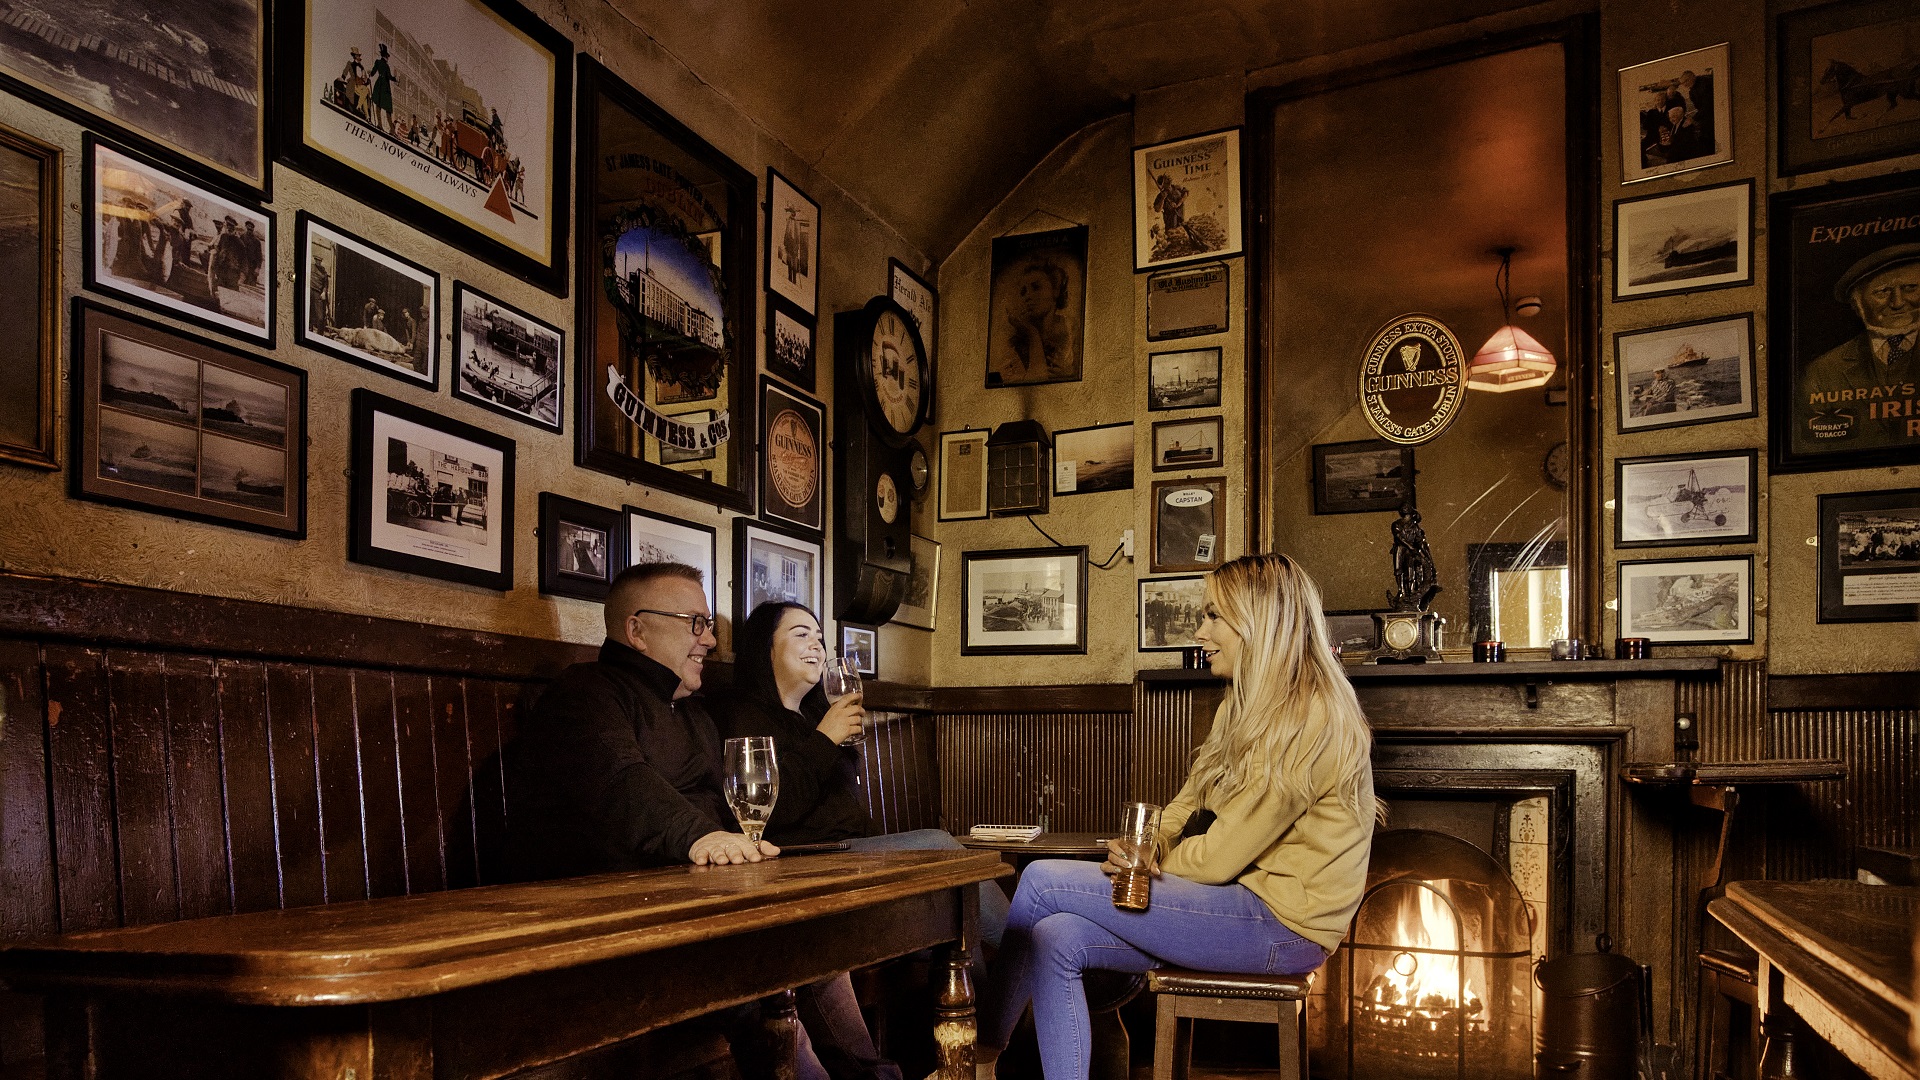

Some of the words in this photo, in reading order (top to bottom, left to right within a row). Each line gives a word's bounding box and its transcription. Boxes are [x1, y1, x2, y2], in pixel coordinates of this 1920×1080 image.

[380, 141, 408, 160] NOW
[410, 159, 431, 174] and
[435, 171, 478, 198] ALWAYS
[1153, 152, 1211, 170] GUINNESS
[1184, 162, 1211, 175] TIME
[894, 275, 917, 303] Herald
[920, 294, 931, 313] Ale
[1366, 327, 1402, 375] GUINNESS
[1404, 322, 1438, 339] EXTRA
[1436, 334, 1458, 367] STOUT
[1365, 367, 1459, 394] GUINNESS
[1808, 382, 1916, 405] MURRAY'S
[614, 382, 697, 450] GUINNESS
[1404, 421, 1433, 437] GATE
[1430, 385, 1457, 426] DUBLIN
[1812, 422, 1850, 431] MURRAY'S
[1814, 430, 1847, 438] TOBACCO
[775, 433, 812, 458] GUINNESS
